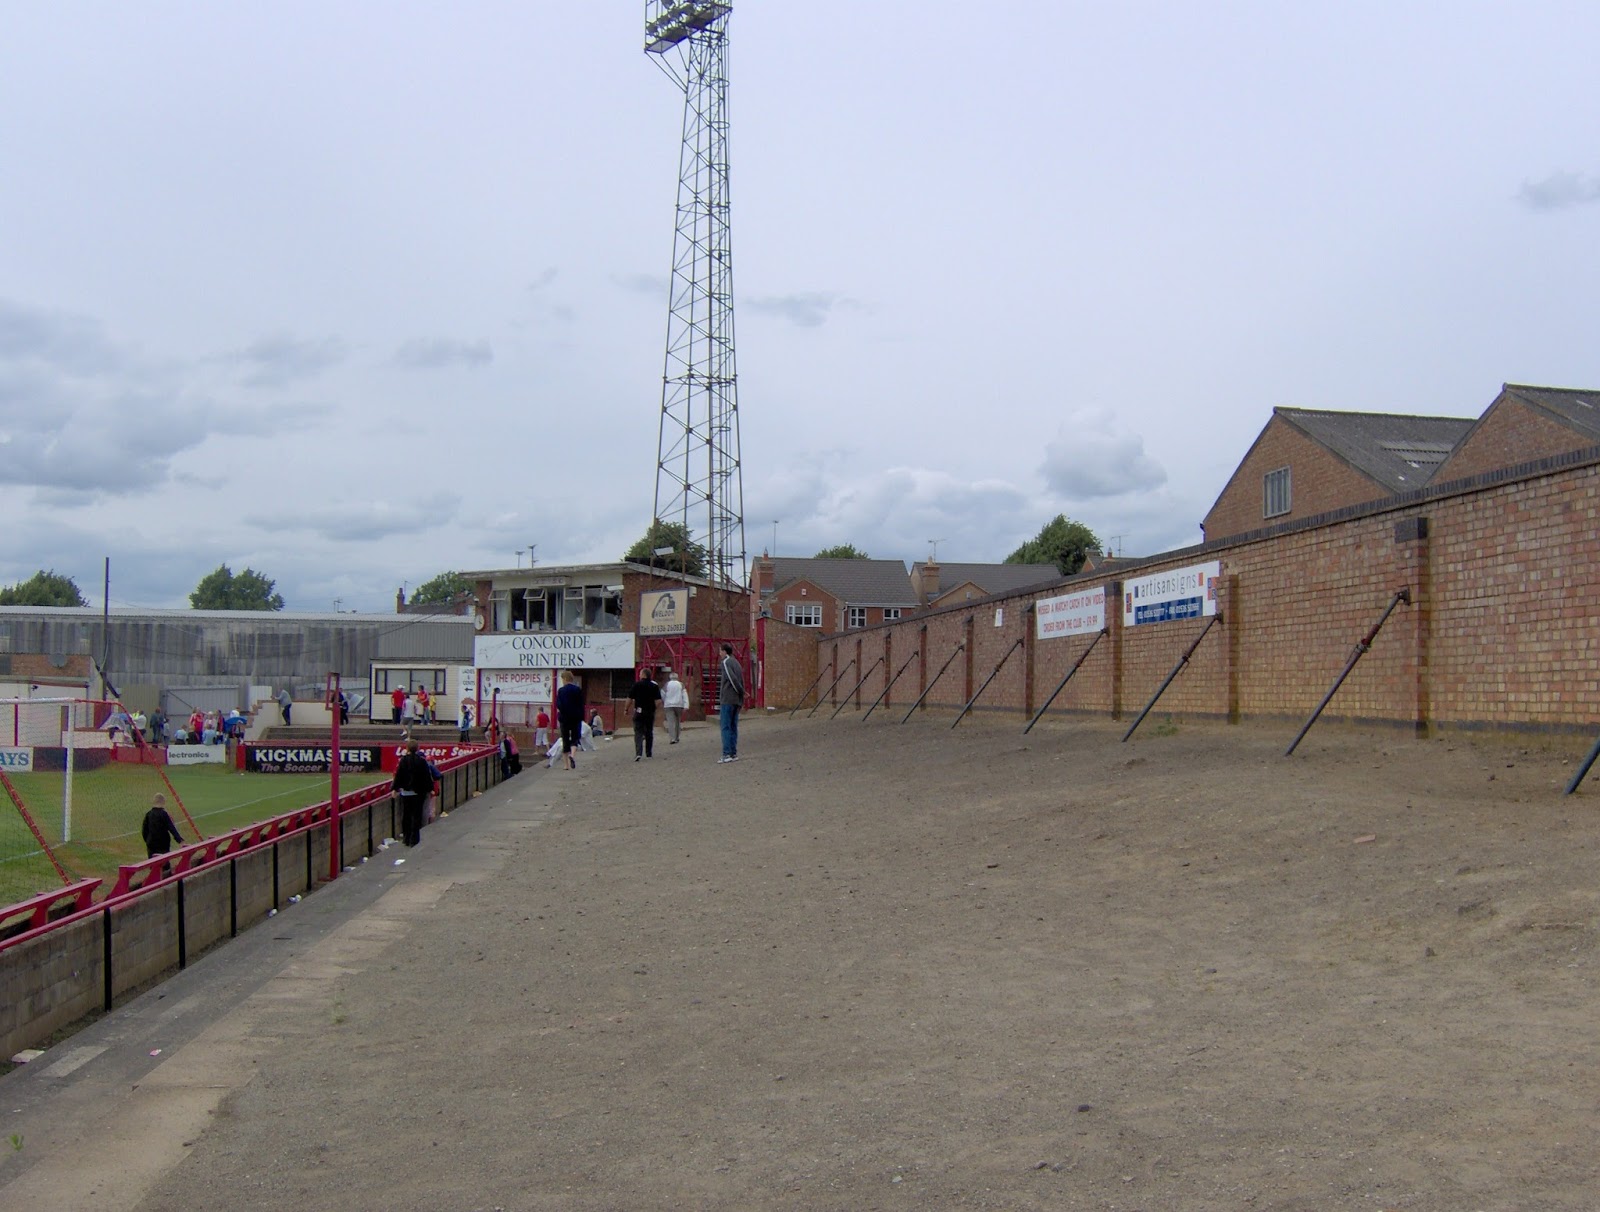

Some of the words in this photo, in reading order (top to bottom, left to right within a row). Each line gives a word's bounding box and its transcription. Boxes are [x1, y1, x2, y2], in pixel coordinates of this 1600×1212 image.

[1141, 573, 1196, 597] artisansigns
[651, 625, 666, 633] 01536
[512, 636, 591, 650] CONCORDE
[519, 653, 584, 666] PRINTERS
[495, 673, 509, 683] THE
[511, 673, 541, 683] POPPIES
[168, 751, 209, 759] lectronics
[255, 749, 372, 762] KICKMASTER
[261, 763, 280, 772] The
[284, 763, 322, 772] Soccer
